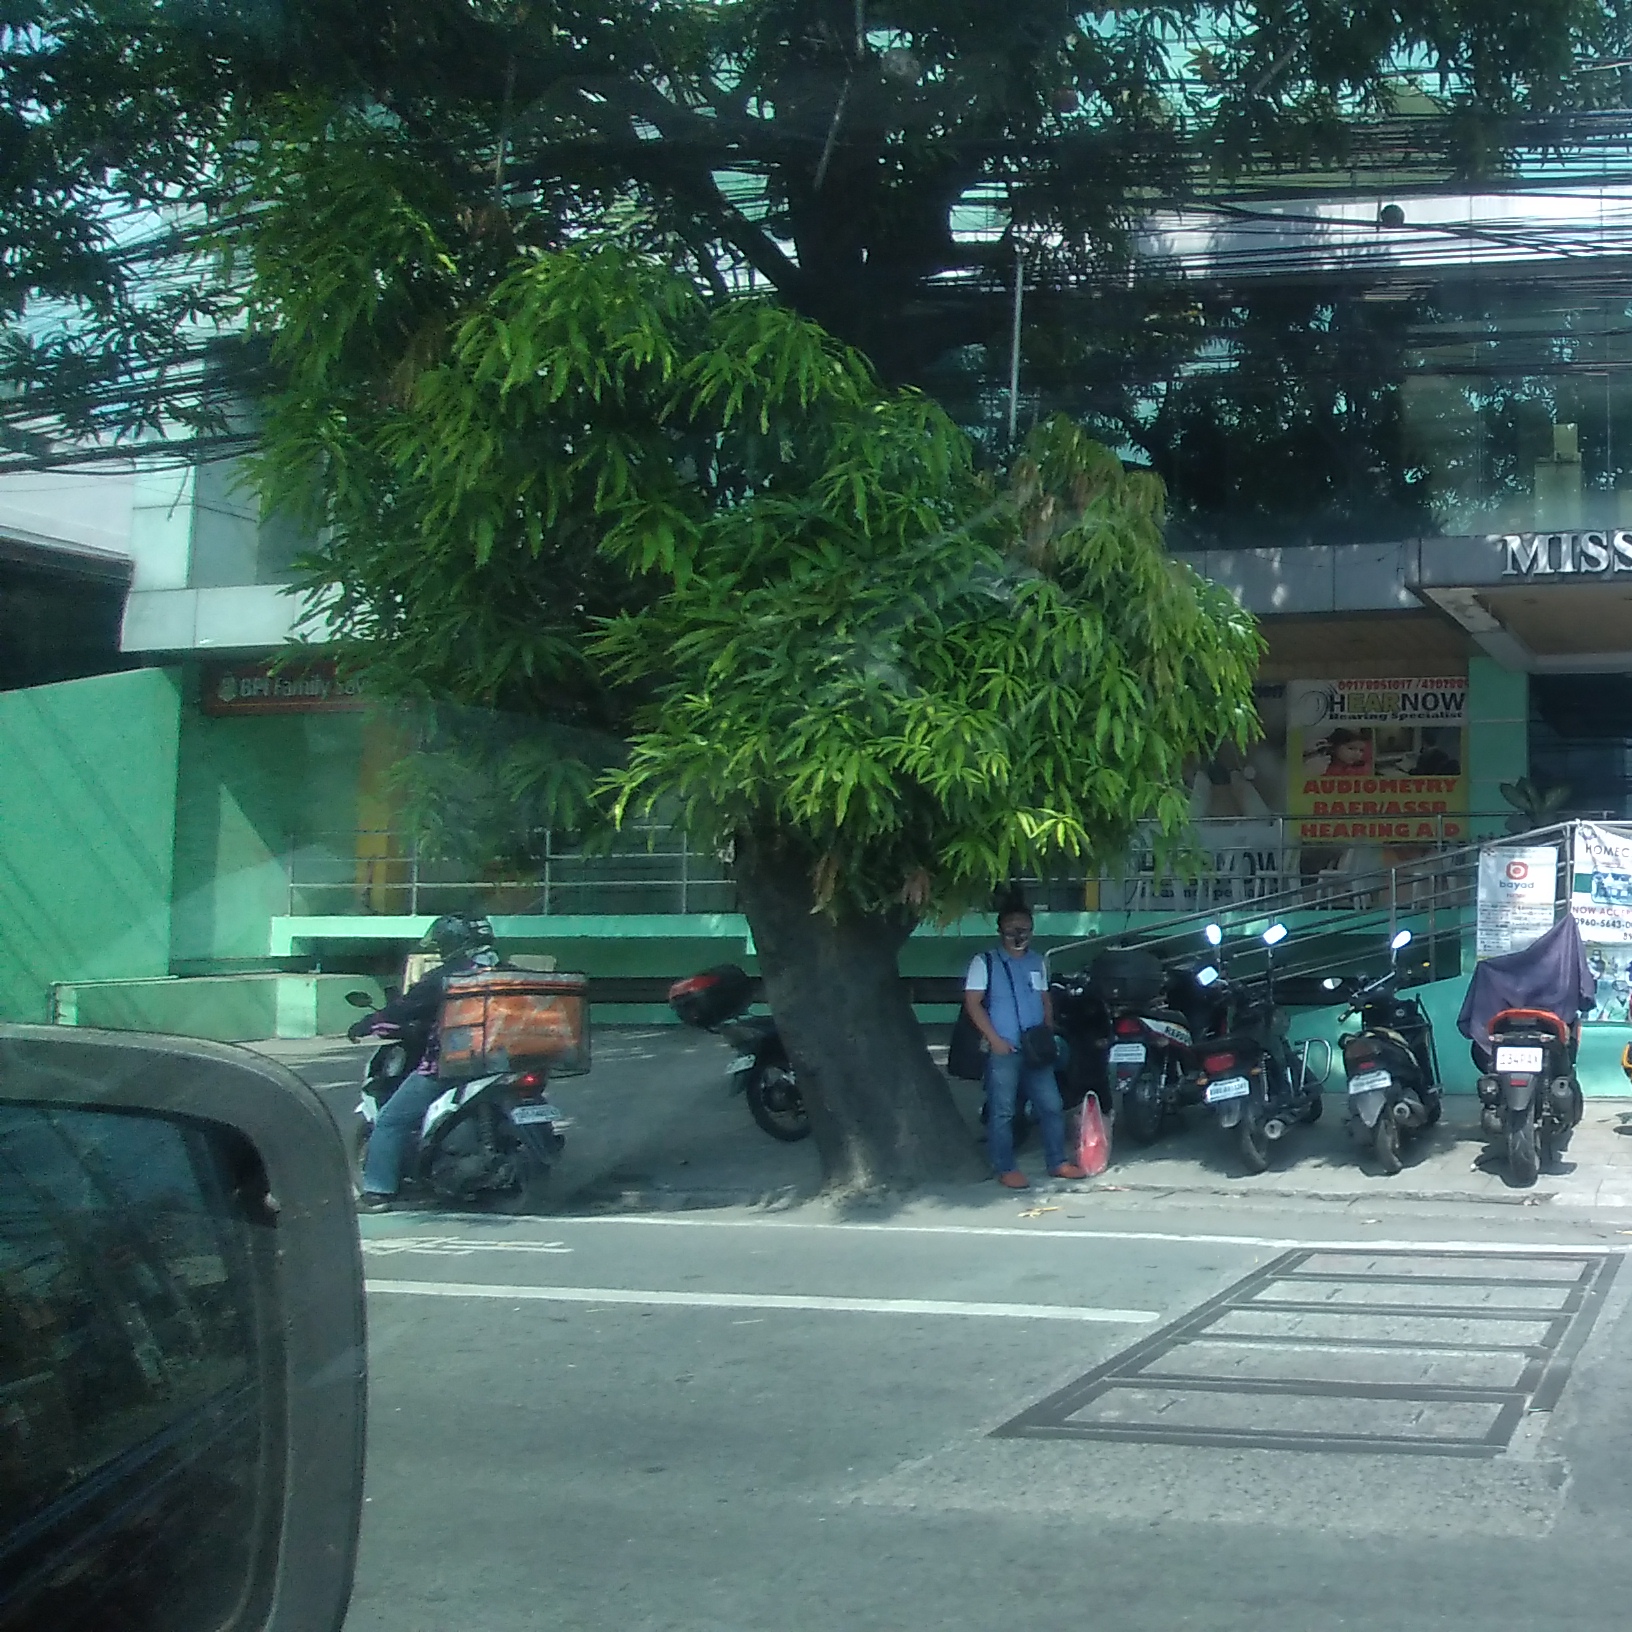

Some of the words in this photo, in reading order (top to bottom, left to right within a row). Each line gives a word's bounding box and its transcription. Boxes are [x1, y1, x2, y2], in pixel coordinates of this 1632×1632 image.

[274, 674, 330, 700] Family
[1329, 713, 1388, 721] Hearing
[1391, 711, 1463, 721] Specialist
[1303, 779, 1458, 794] AUDIOMETRY
[1301, 823, 1410, 837] HEARING
[1498, 880, 1535, 890] bayad
[1572, 906, 1596, 914] NOW
